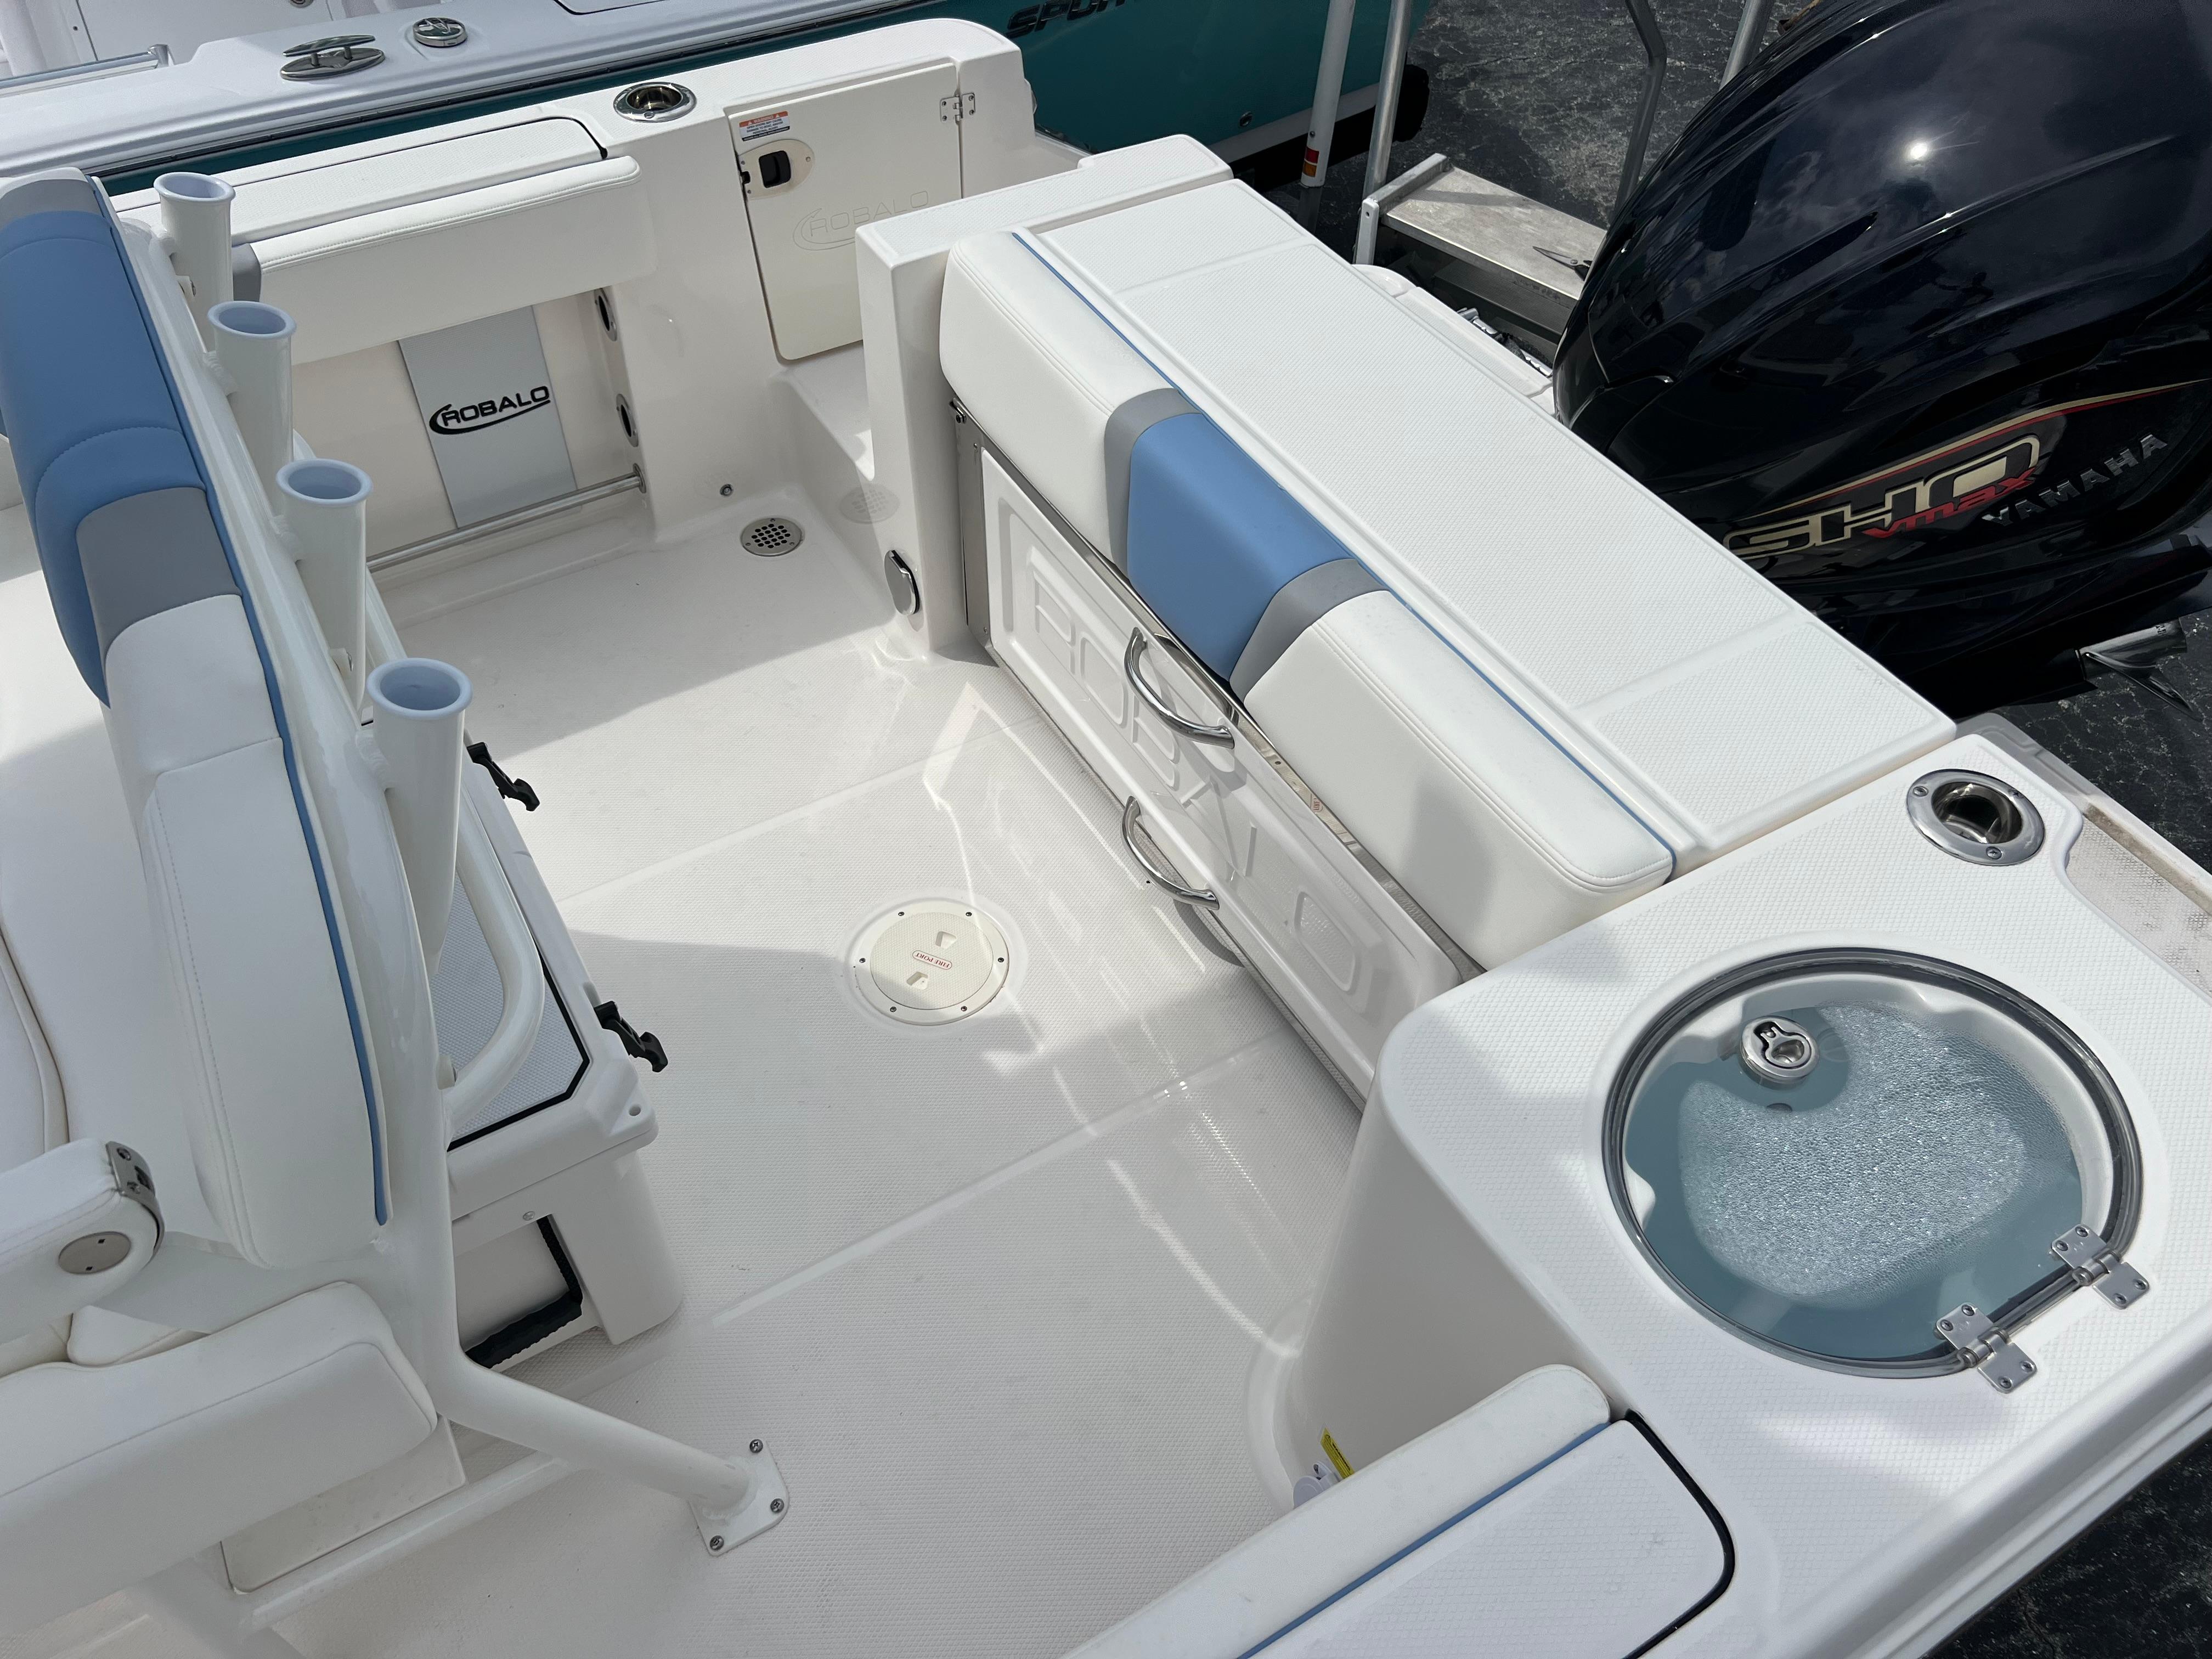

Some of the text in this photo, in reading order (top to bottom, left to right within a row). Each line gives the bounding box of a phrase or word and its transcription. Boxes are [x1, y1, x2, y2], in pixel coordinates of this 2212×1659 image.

[1006, 0, 1126, 39] SPO
[809, 190, 929, 237] ROBALO
[441, 385, 550, 427] ROBALO
[1982, 434, 2168, 527] YAMAHA
[1032, 568, 1358, 994] ROBALO
[915, 952, 933, 962] PORT
